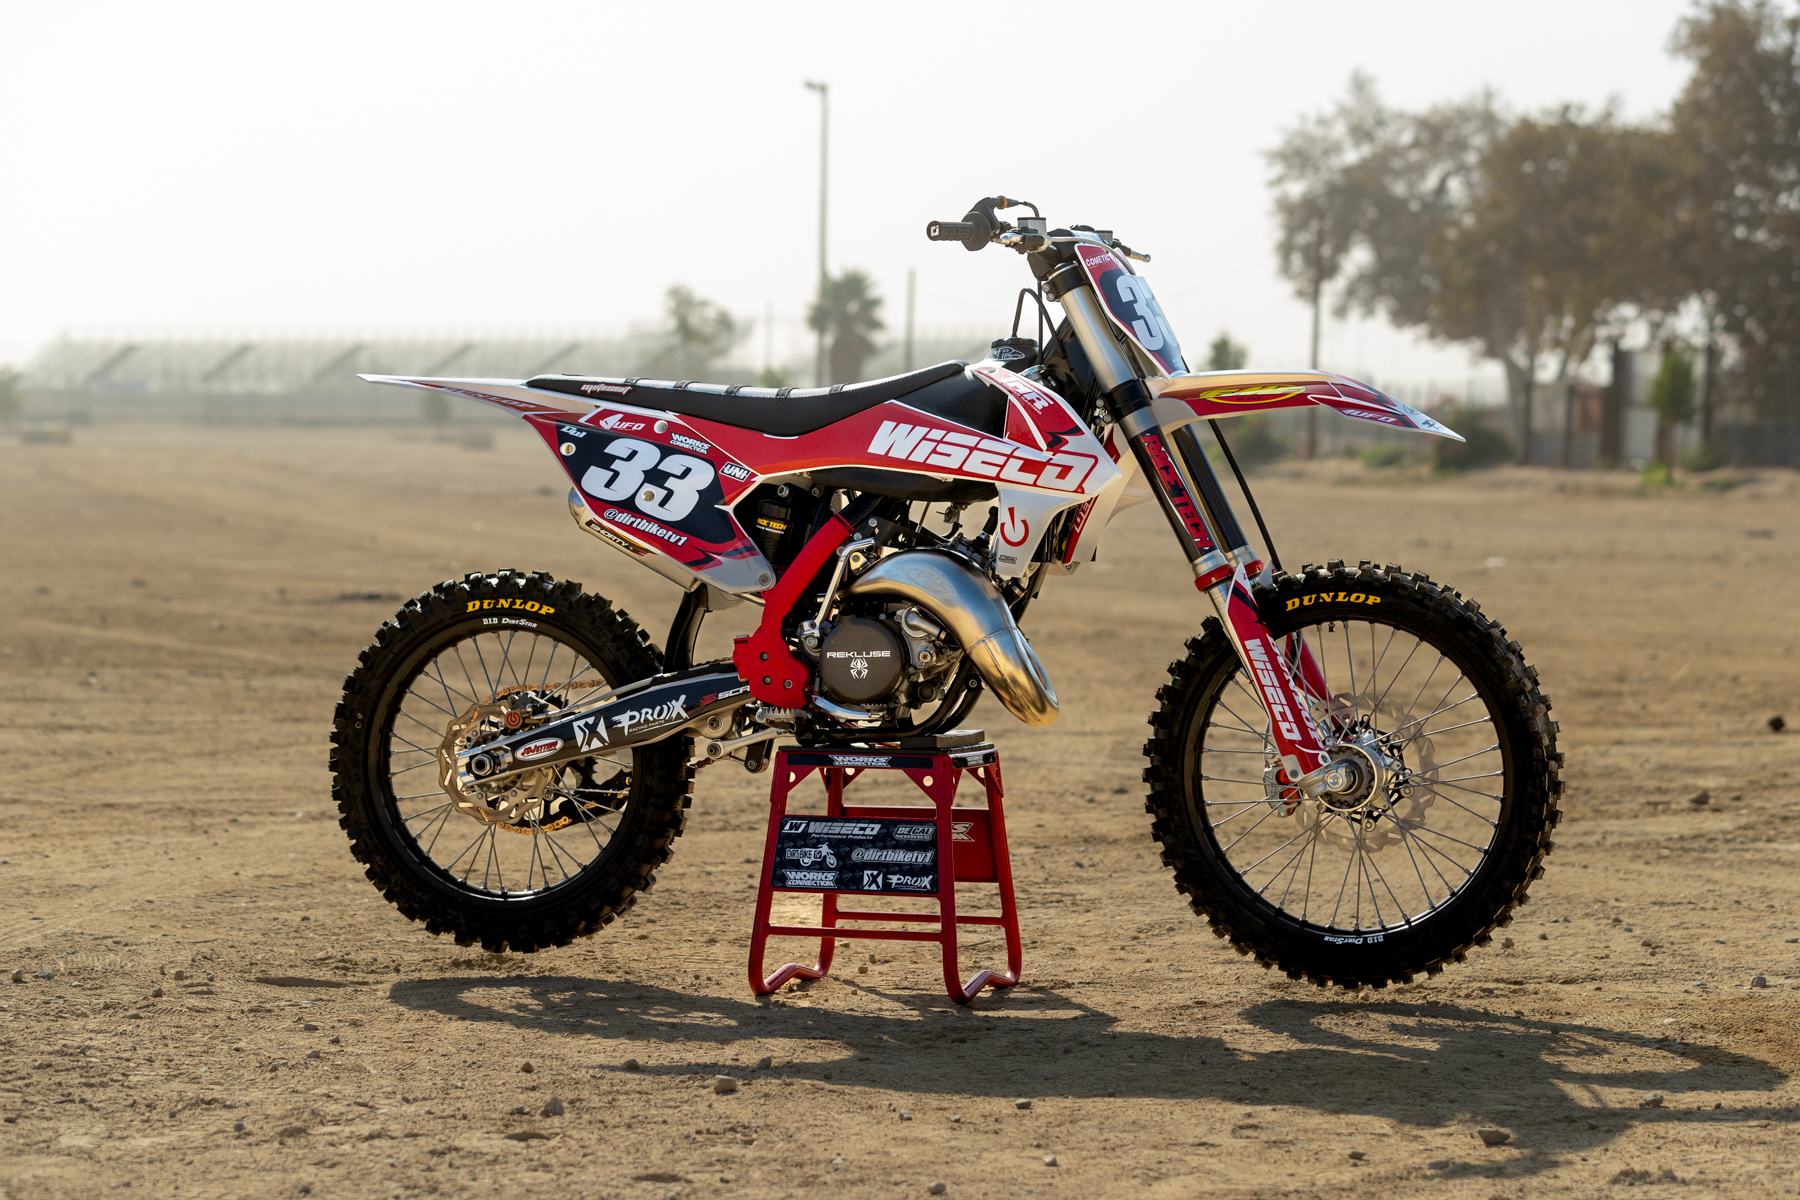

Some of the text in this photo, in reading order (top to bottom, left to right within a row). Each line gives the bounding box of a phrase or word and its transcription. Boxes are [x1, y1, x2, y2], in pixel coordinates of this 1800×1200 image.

[1351, 410, 1397, 423] UFO
[613, 421, 646, 431] UFO
[669, 440, 708, 455] CONNECTION
[671, 433, 712, 450] WORKS
[723, 464, 749, 479] UNI
[580, 438, 715, 522] 33
[603, 508, 689, 547] @dirtbiketv1
[1172, 490, 1214, 549] TECH
[589, 523, 629, 547] SHORTY
[466, 598, 555, 615] DUNLOP
[1285, 592, 1381, 612] DUNLOP
[826, 650, 891, 658] REKLUSE
[628, 724, 648, 733] RACING
[852, 848, 934, 864] @dirtbiketv1
[787, 872, 836, 880] WORKS
